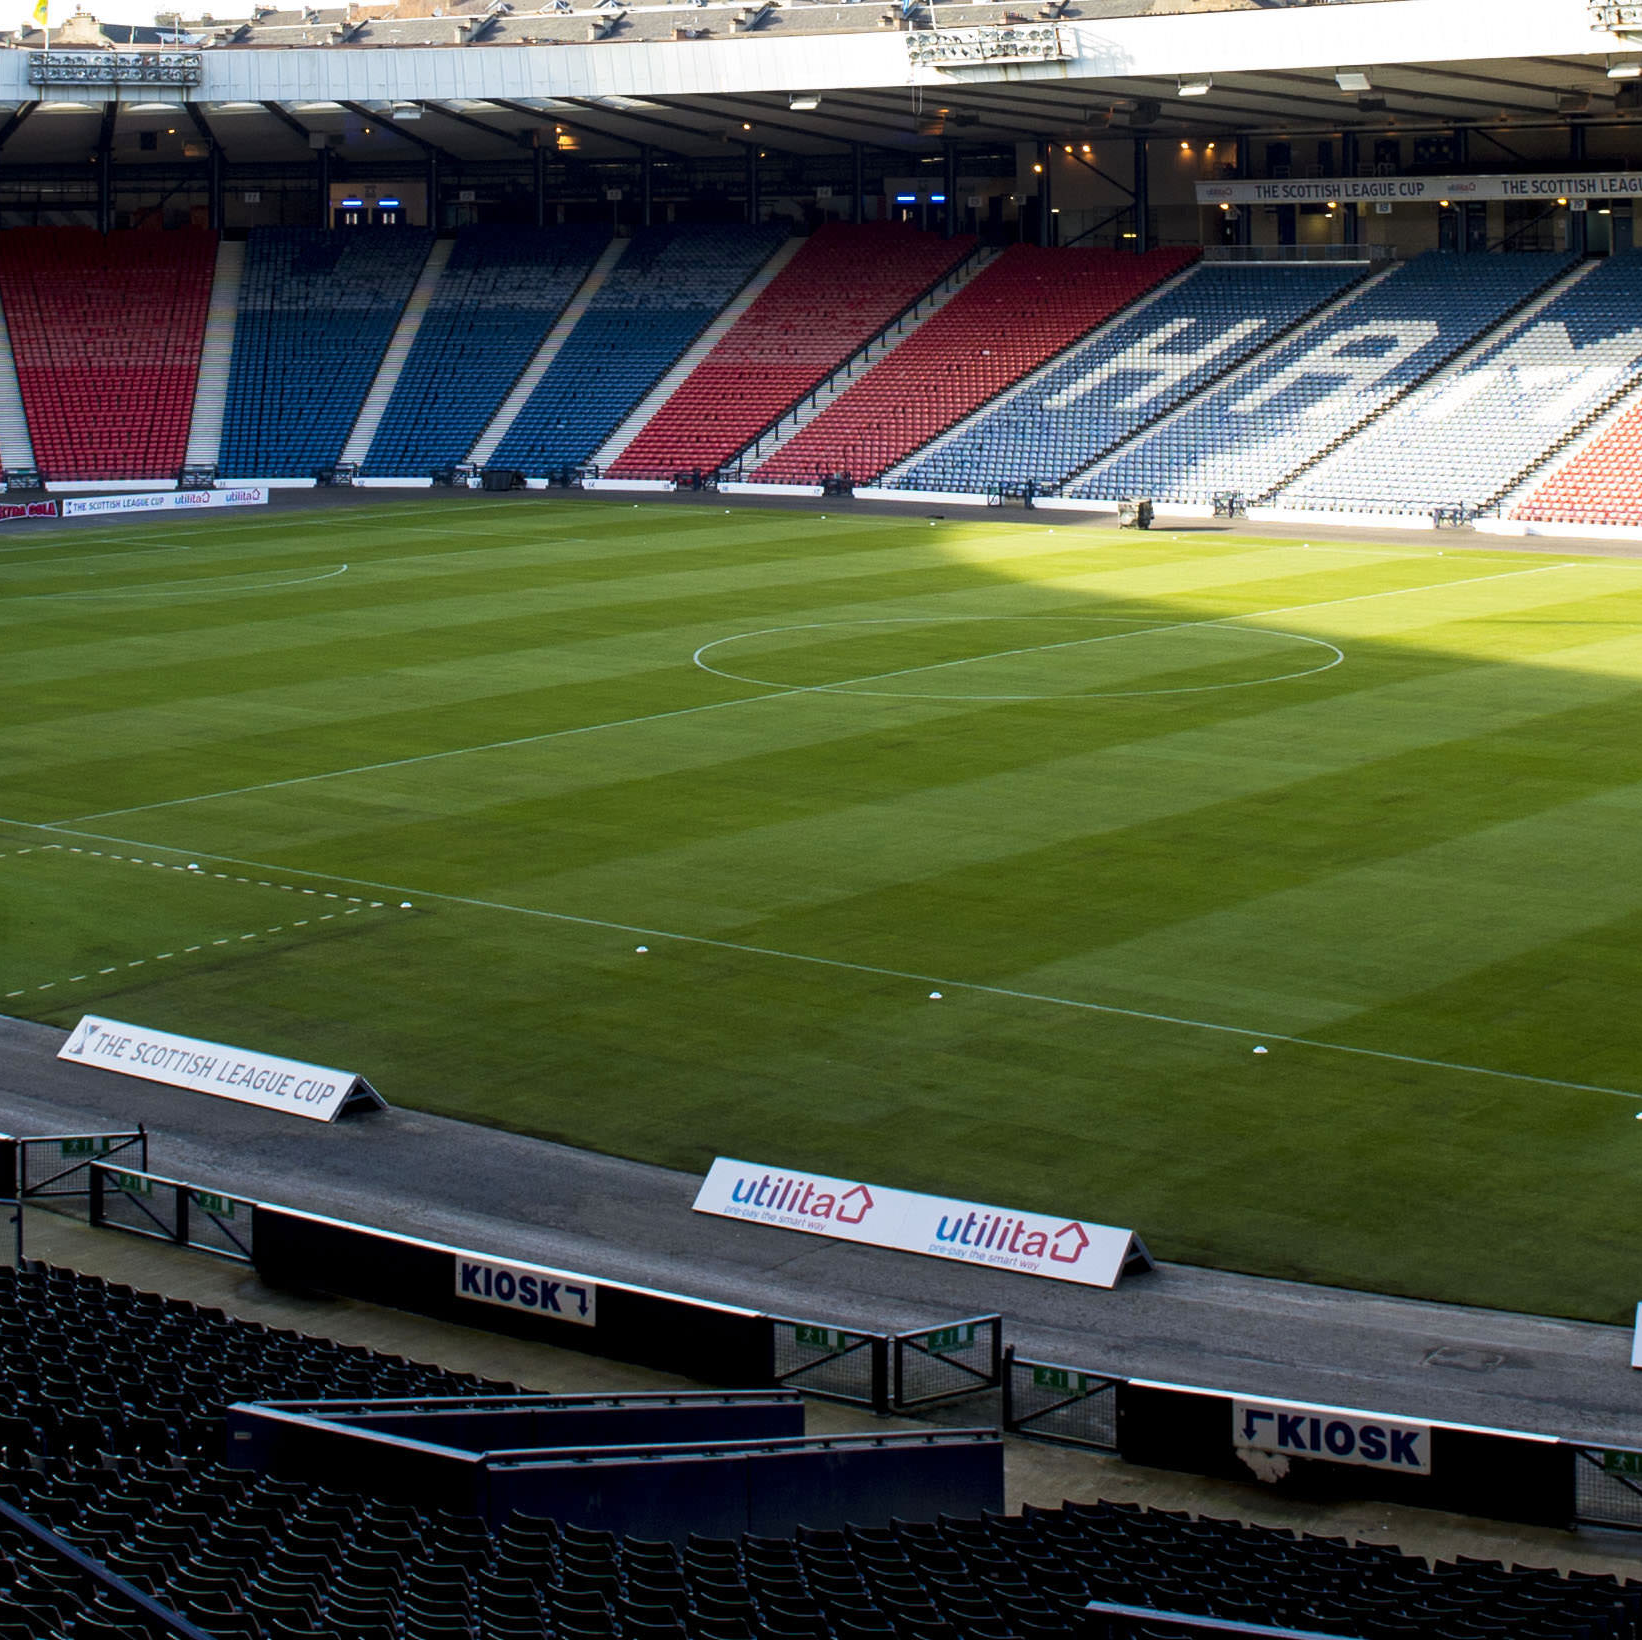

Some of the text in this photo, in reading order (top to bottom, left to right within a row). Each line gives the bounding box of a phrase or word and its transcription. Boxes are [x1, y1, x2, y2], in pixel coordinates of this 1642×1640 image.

[1254, 182, 1424, 198] THE SCOTTISH LEAGUE CUP
[1501, 180, 1528, 194] THE
[1531, 179, 1596, 194] SCOTTISH
[1573, 200, 1584, 209] 19
[73, 496, 165, 512] THE SCOTTISH LEAGUE CUP
[174, 494, 202, 506] utilita
[225, 491, 252, 503] utilita
[28, 501, 57, 517] COLA
[92, 1032, 336, 1105] THE SCOTTISH LEAGUE CUP
[731, 1174, 836, 1219] utilita
[723, 1205, 827, 1232] pre-pay the smart way
[935, 1212, 1049, 1258] utilita
[927, 1241, 1041, 1272] pre-pay the smart way
[461, 1262, 562, 1313] KIOSK
[1277, 1412, 1421, 1467] KIOSK
